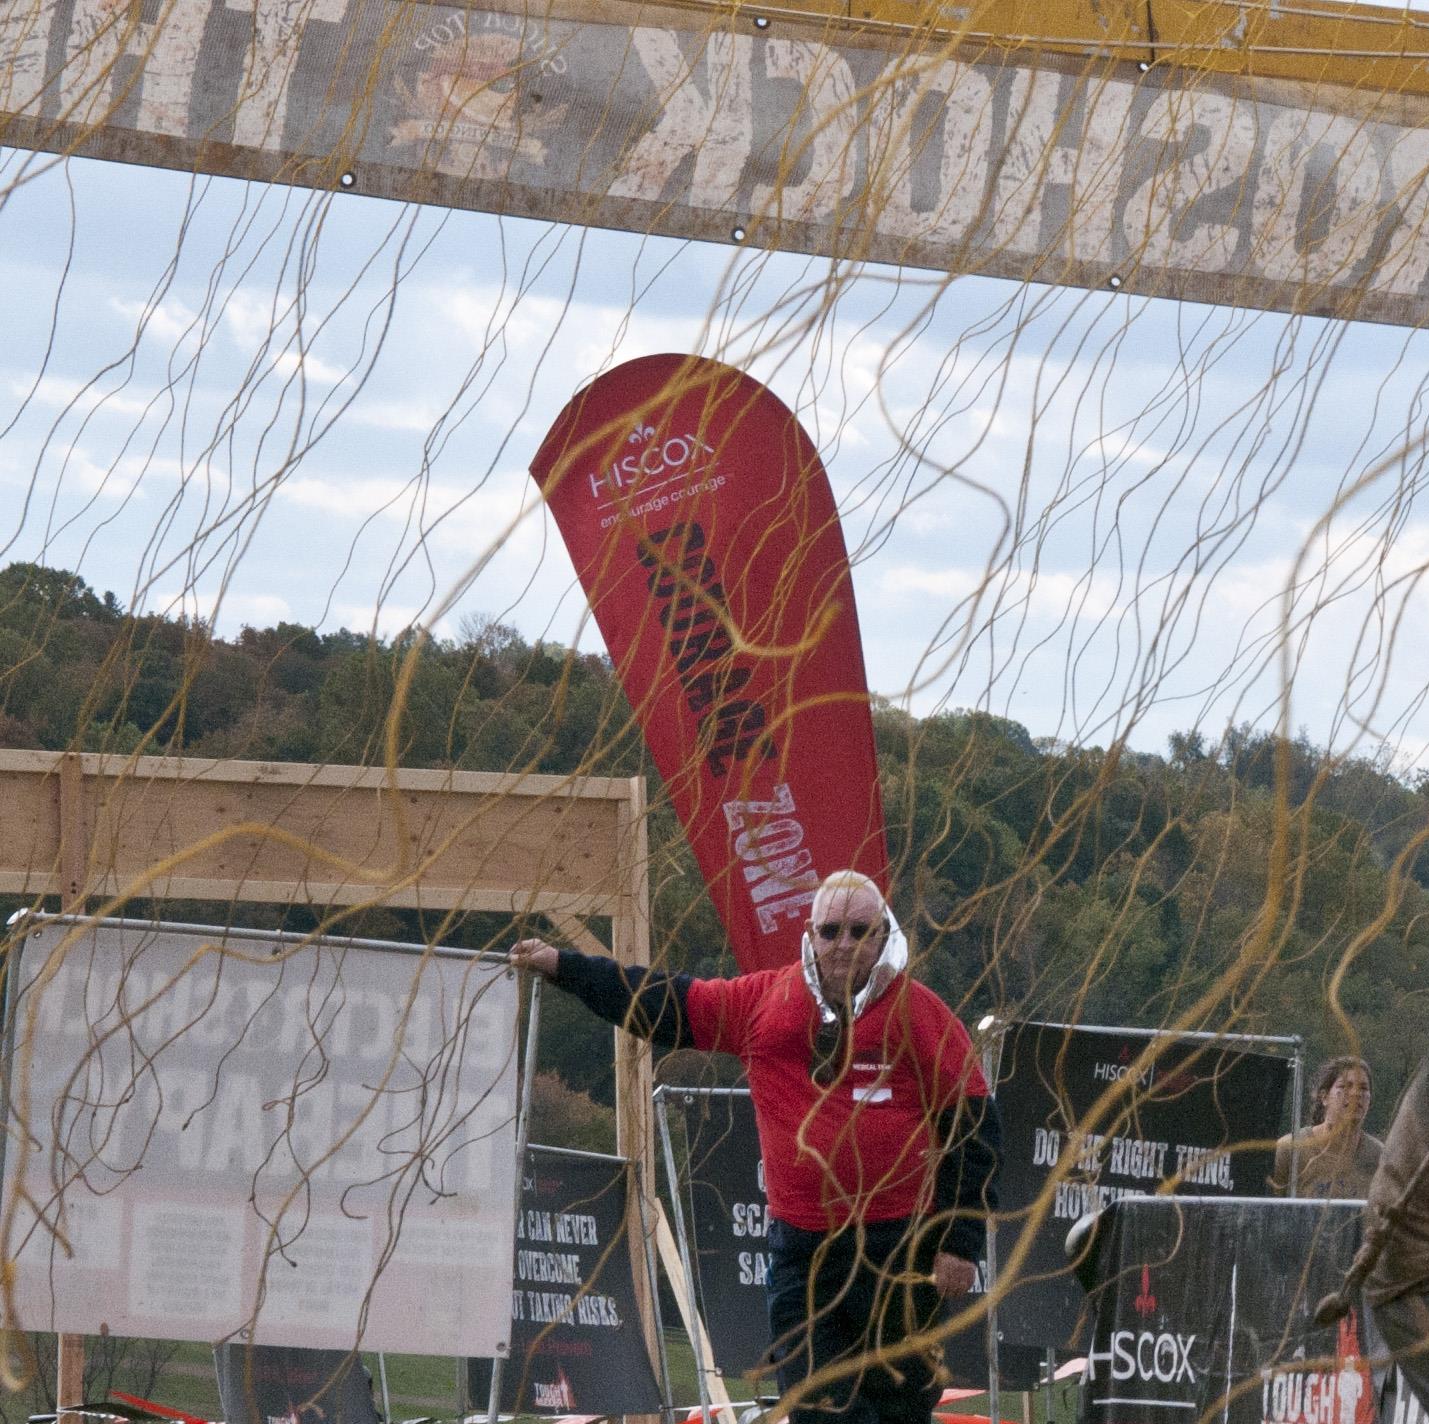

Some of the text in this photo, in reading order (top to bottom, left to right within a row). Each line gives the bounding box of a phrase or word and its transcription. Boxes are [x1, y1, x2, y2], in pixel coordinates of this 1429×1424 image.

[589, 433, 715, 498] HISCOX
[600, 494, 669, 529] encurage
[636, 522, 820, 935] COURAGE ZONE
[1033, 1128, 1060, 1167] DO
[1110, 1136, 1169, 1180] RIGHT
[527, 1209, 553, 1242] CAN
[555, 1212, 599, 1246] NEVER
[1260, 1367, 1336, 1424] TOUGH
